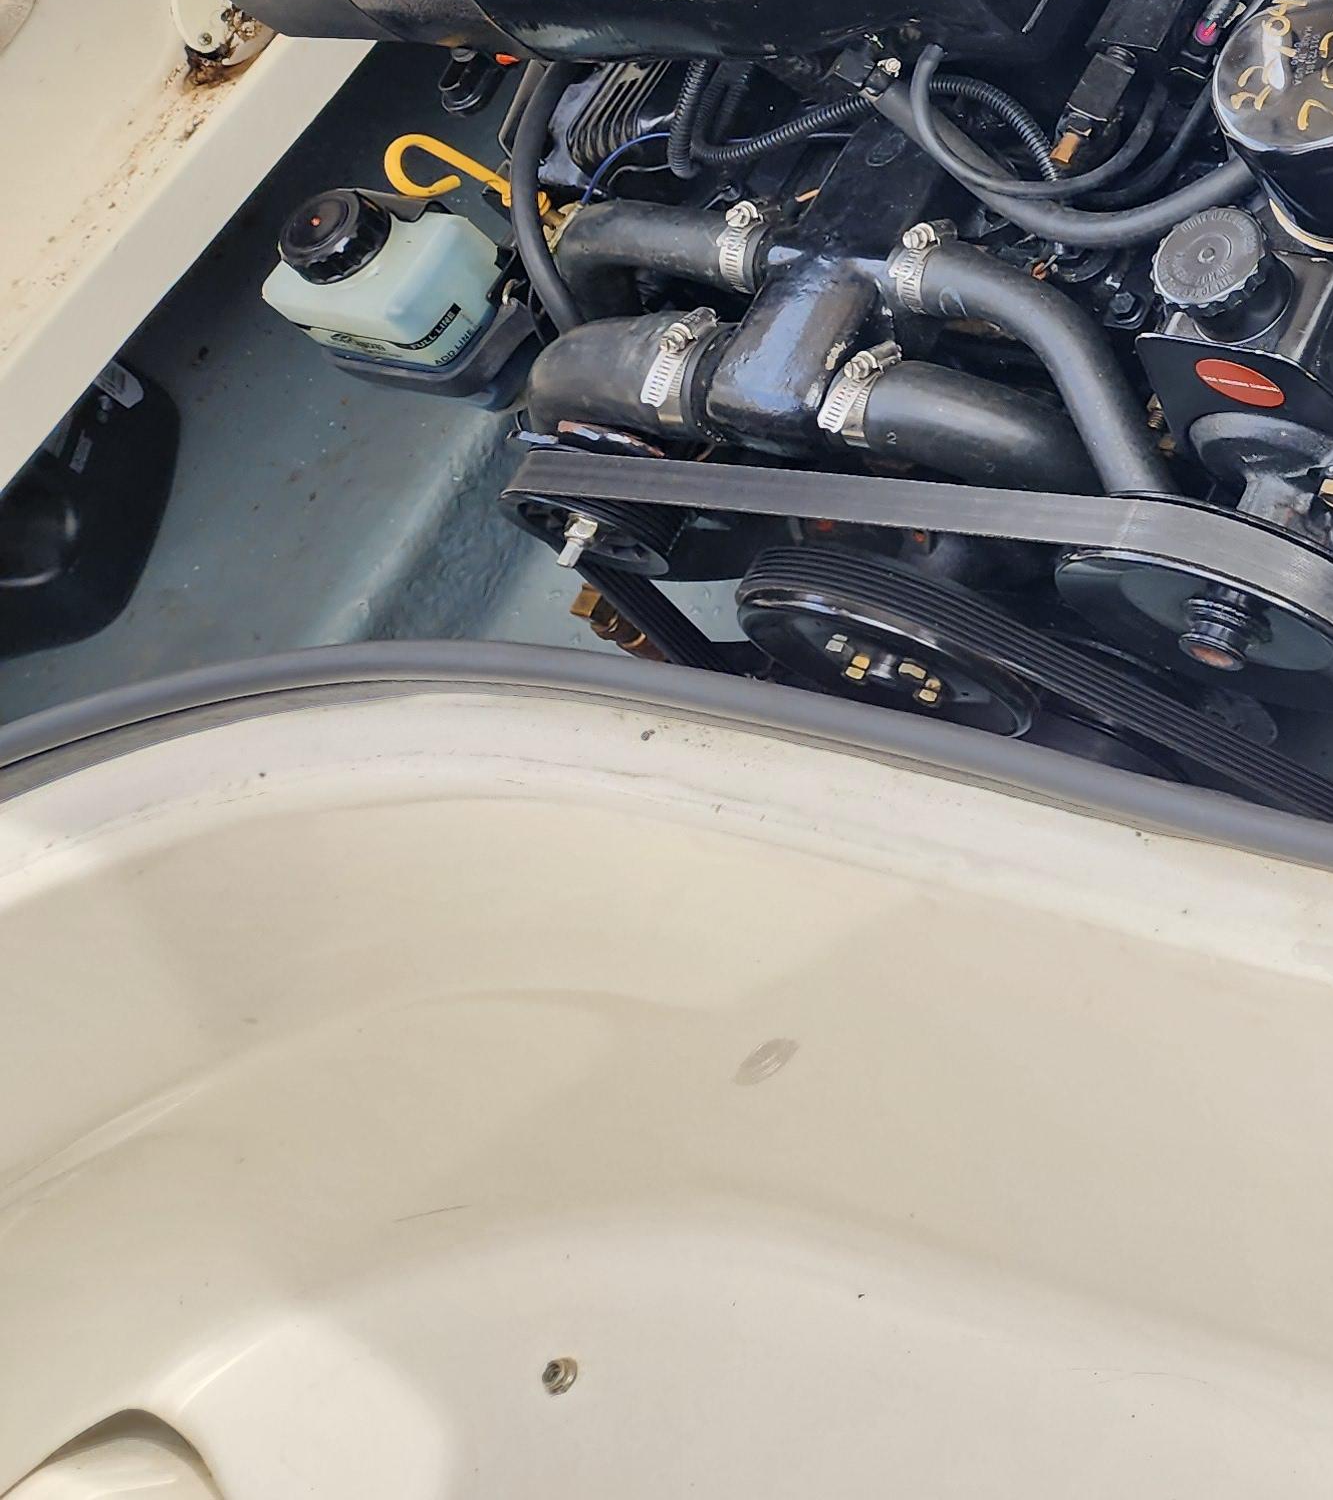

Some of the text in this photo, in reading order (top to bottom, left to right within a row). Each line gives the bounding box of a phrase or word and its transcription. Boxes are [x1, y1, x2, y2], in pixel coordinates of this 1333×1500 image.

[411, 333, 437, 350] FULL
[436, 308, 457, 334] LINE
[434, 349, 456, 365] ADD
